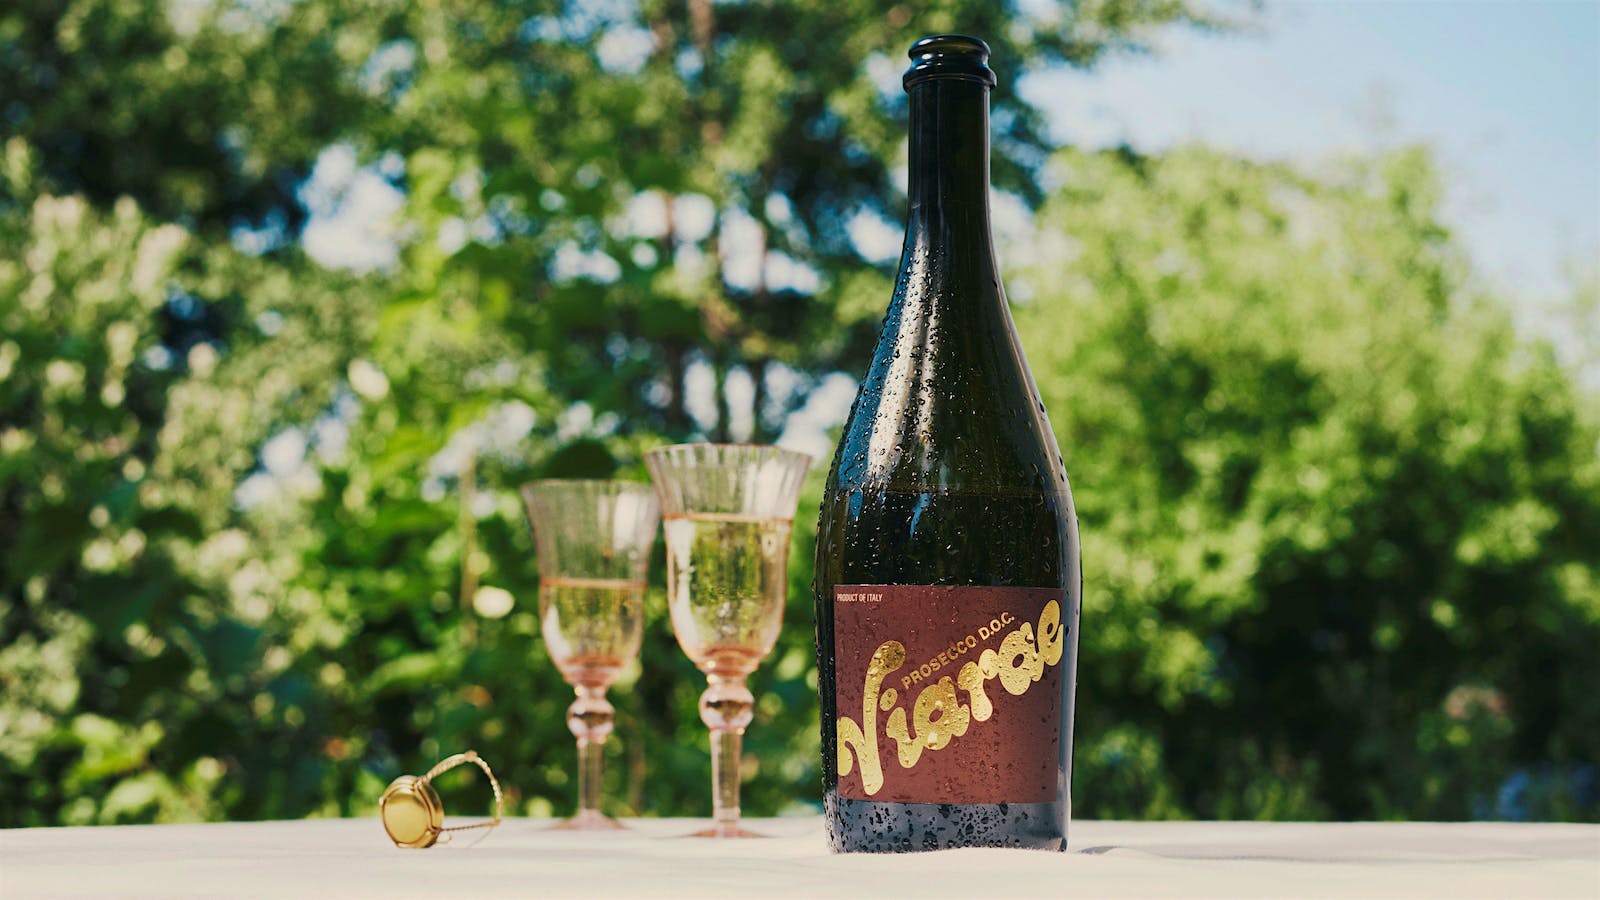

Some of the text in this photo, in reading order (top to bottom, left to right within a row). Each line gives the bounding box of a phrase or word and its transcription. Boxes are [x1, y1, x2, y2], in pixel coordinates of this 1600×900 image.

[836, 593, 883, 602] PRODUCT OF ITALY
[901, 611, 1015, 690] PROSECCO D.O.C.
[837, 600, 1064, 795] Viarae
